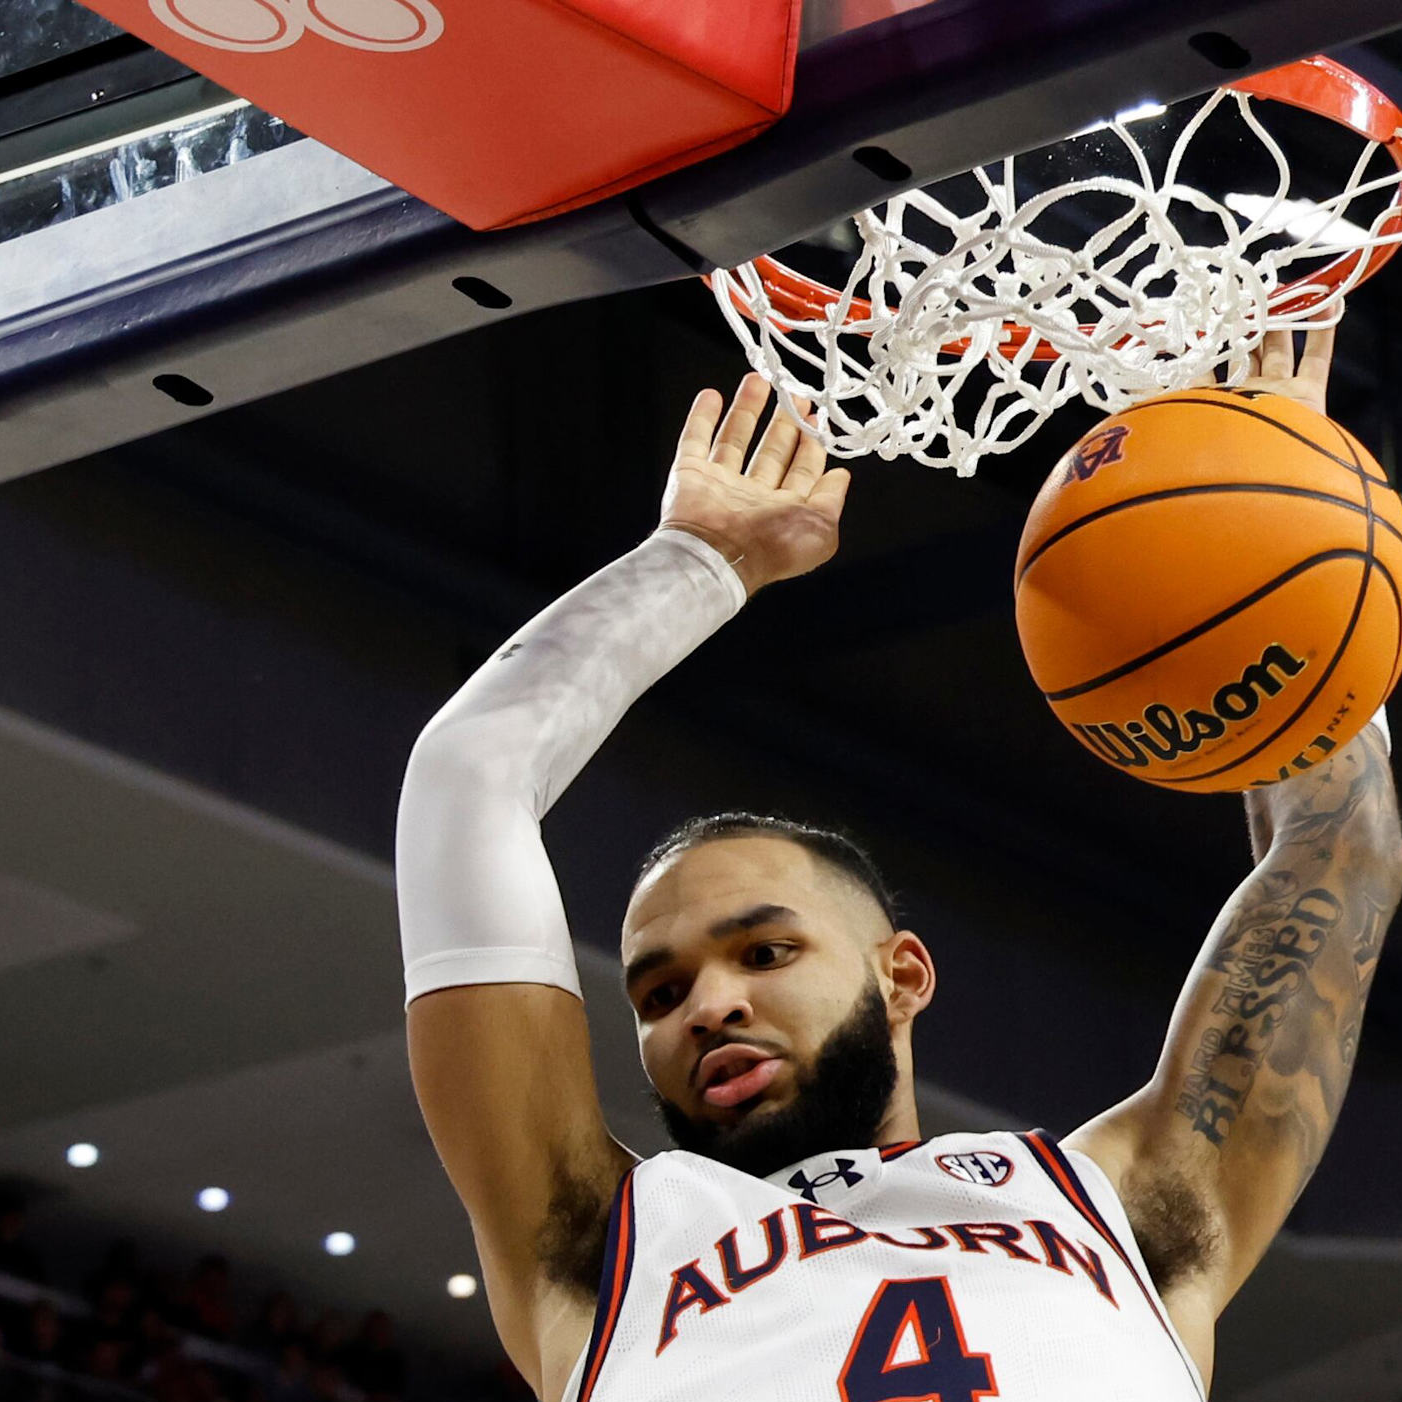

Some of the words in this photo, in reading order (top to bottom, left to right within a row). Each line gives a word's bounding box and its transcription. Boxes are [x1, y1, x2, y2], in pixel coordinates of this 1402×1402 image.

[1070, 642, 1310, 768] Wilson
[1193, 887, 1343, 1145] BLESSED
[938, 1152, 1010, 1185] SEC
